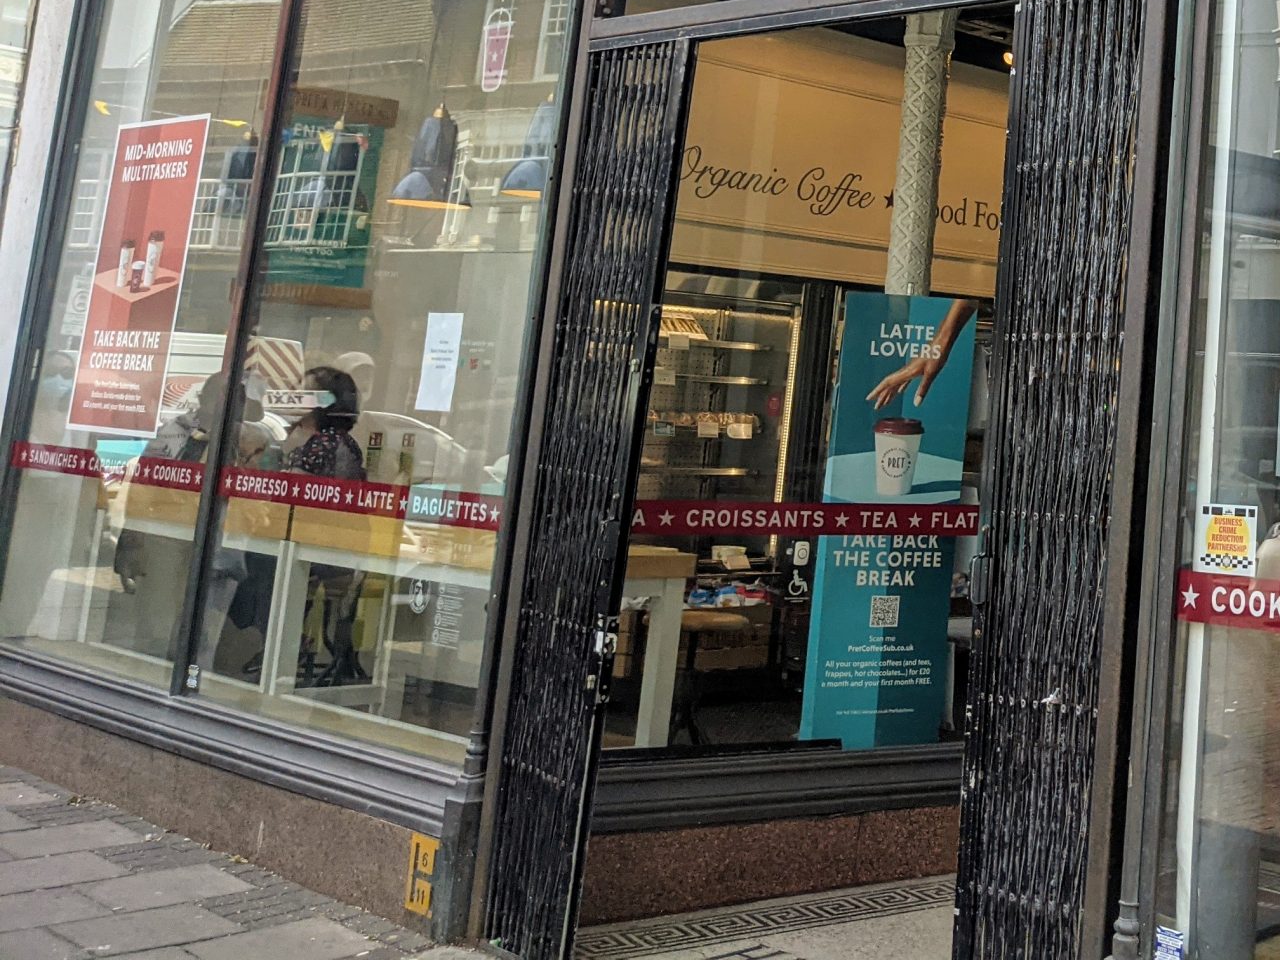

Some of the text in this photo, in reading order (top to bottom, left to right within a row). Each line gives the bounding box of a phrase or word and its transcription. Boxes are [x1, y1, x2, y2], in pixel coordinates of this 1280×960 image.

[125, 139, 193, 161] MID-MORNING
[122, 161, 188, 182] MULTITASKERS
[679, 145, 790, 199] Organic
[797, 166, 876, 216] Coffee
[936, 198, 967, 226] od
[93, 330, 161, 349] TAKE BACK THE
[880, 323, 935, 341] LATTE
[870, 340, 942, 360] LOVERS
[89, 352, 154, 372] COFFEE BREAK
[28, 451, 78, 470] SANDWICHES
[153, 464, 191, 484] COOKIES
[887, 457, 906, 469] PRET
[235, 474, 488, 523] ESPRESSO SOUPS LATTE BAGUETTES
[686, 508, 825, 528] CROISSANTS
[860, 510, 899, 529] TEA
[931, 511, 979, 530] FLAT
[1214, 517, 1243, 527] BUSINESS
[1211, 534, 1244, 544] REDUCTION
[1218, 526, 1237, 535] CRIME
[841, 535, 939, 549] TAKE BACK
[1207, 542, 1247, 553] PARTNERSHIP
[833, 550, 942, 568] THE COFFEE
[856, 570, 916, 587] BREAK
